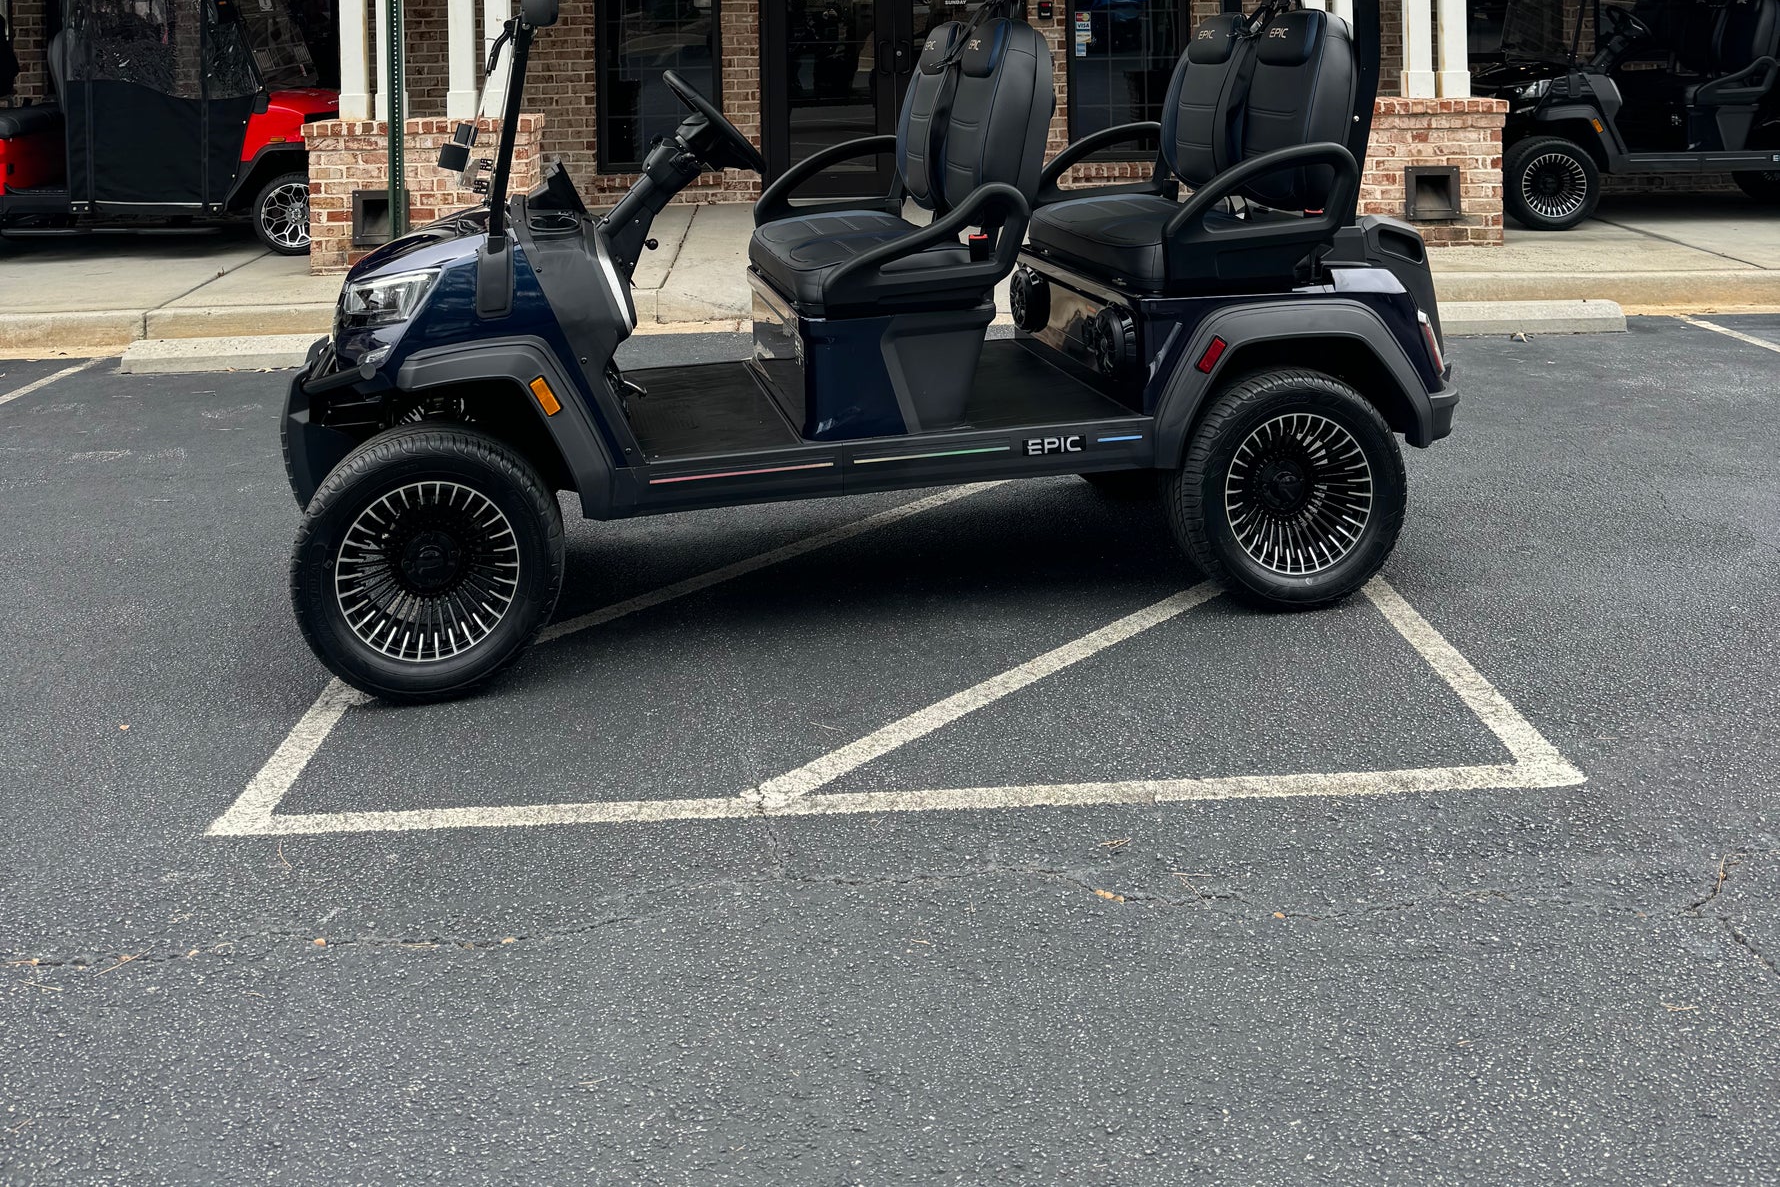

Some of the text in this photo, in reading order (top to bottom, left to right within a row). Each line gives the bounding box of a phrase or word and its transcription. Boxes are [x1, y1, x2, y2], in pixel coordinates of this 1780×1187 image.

[1198, 29, 1215, 40] EPIC
[1269, 27, 1289, 39] EPIC
[1027, 436, 1082, 455] EPIC
